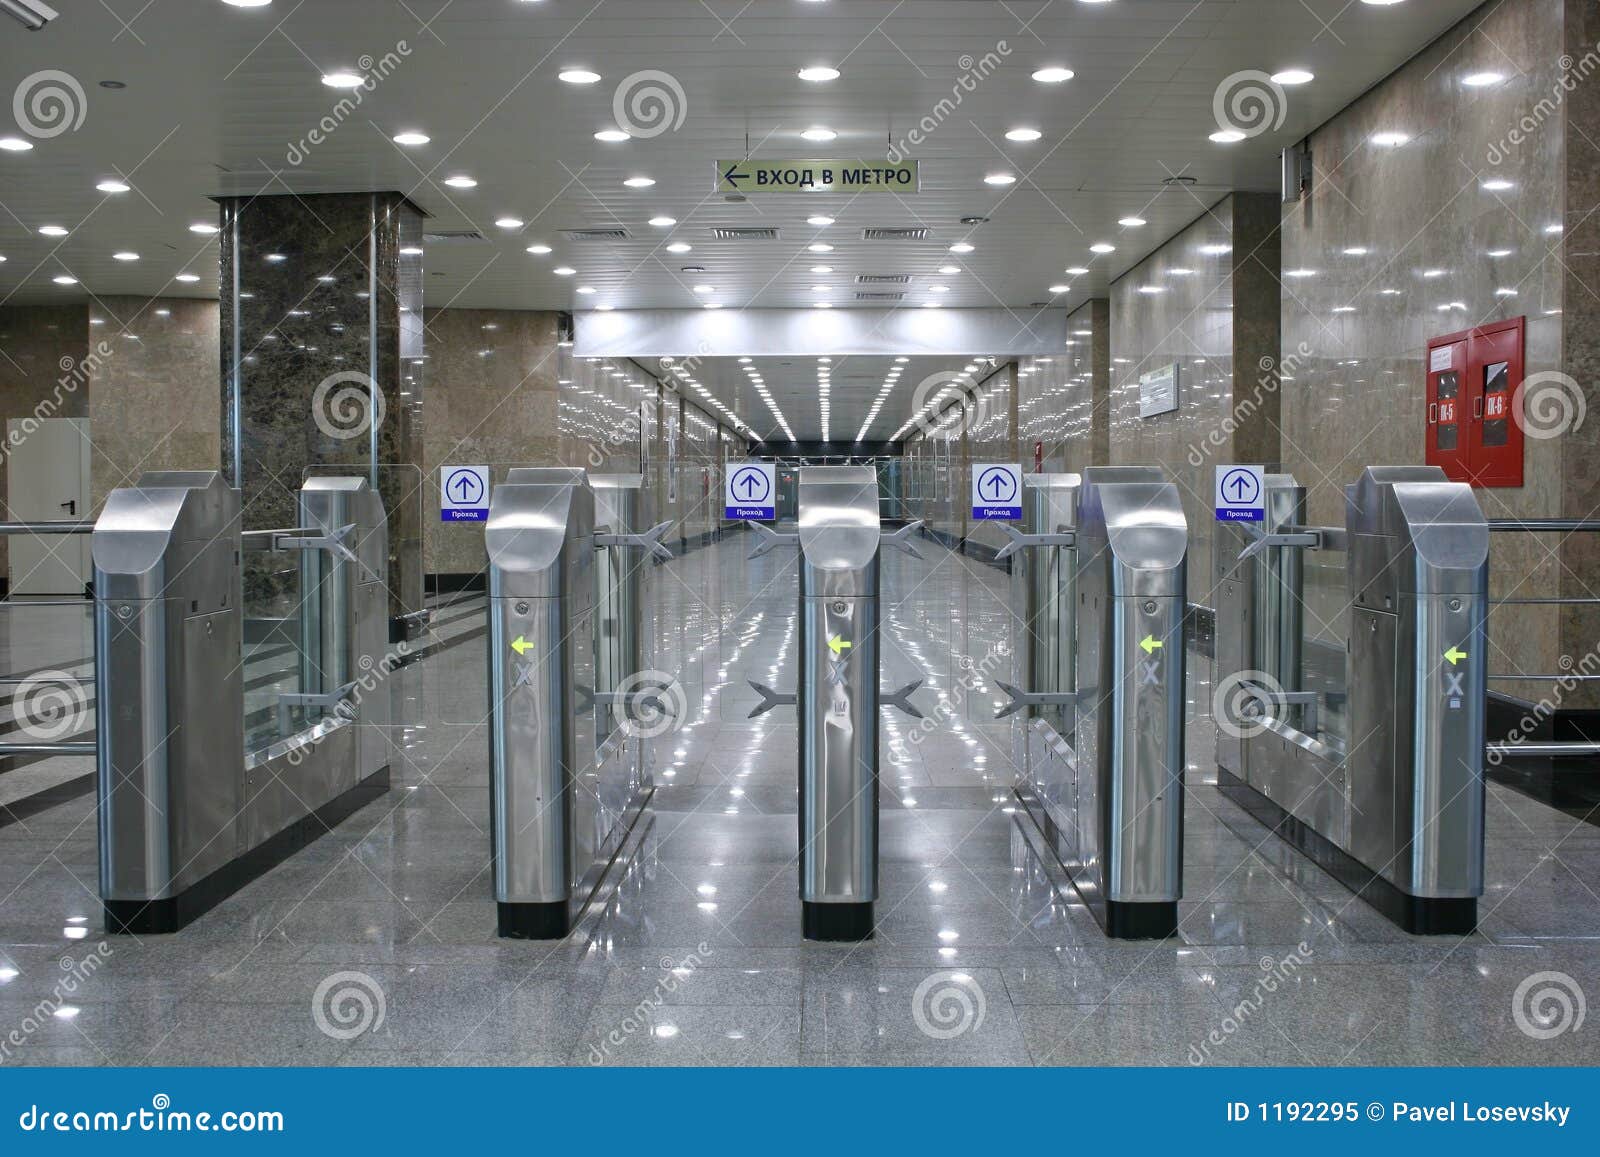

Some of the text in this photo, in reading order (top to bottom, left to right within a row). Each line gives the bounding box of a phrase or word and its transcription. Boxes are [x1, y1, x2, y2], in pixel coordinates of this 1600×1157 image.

[756, 168, 912, 188] ВХОД В МЕТРО
[736, 508, 764, 517] Проход
[983, 508, 1011, 517] Проход
[1226, 510, 1253, 518] Проход
